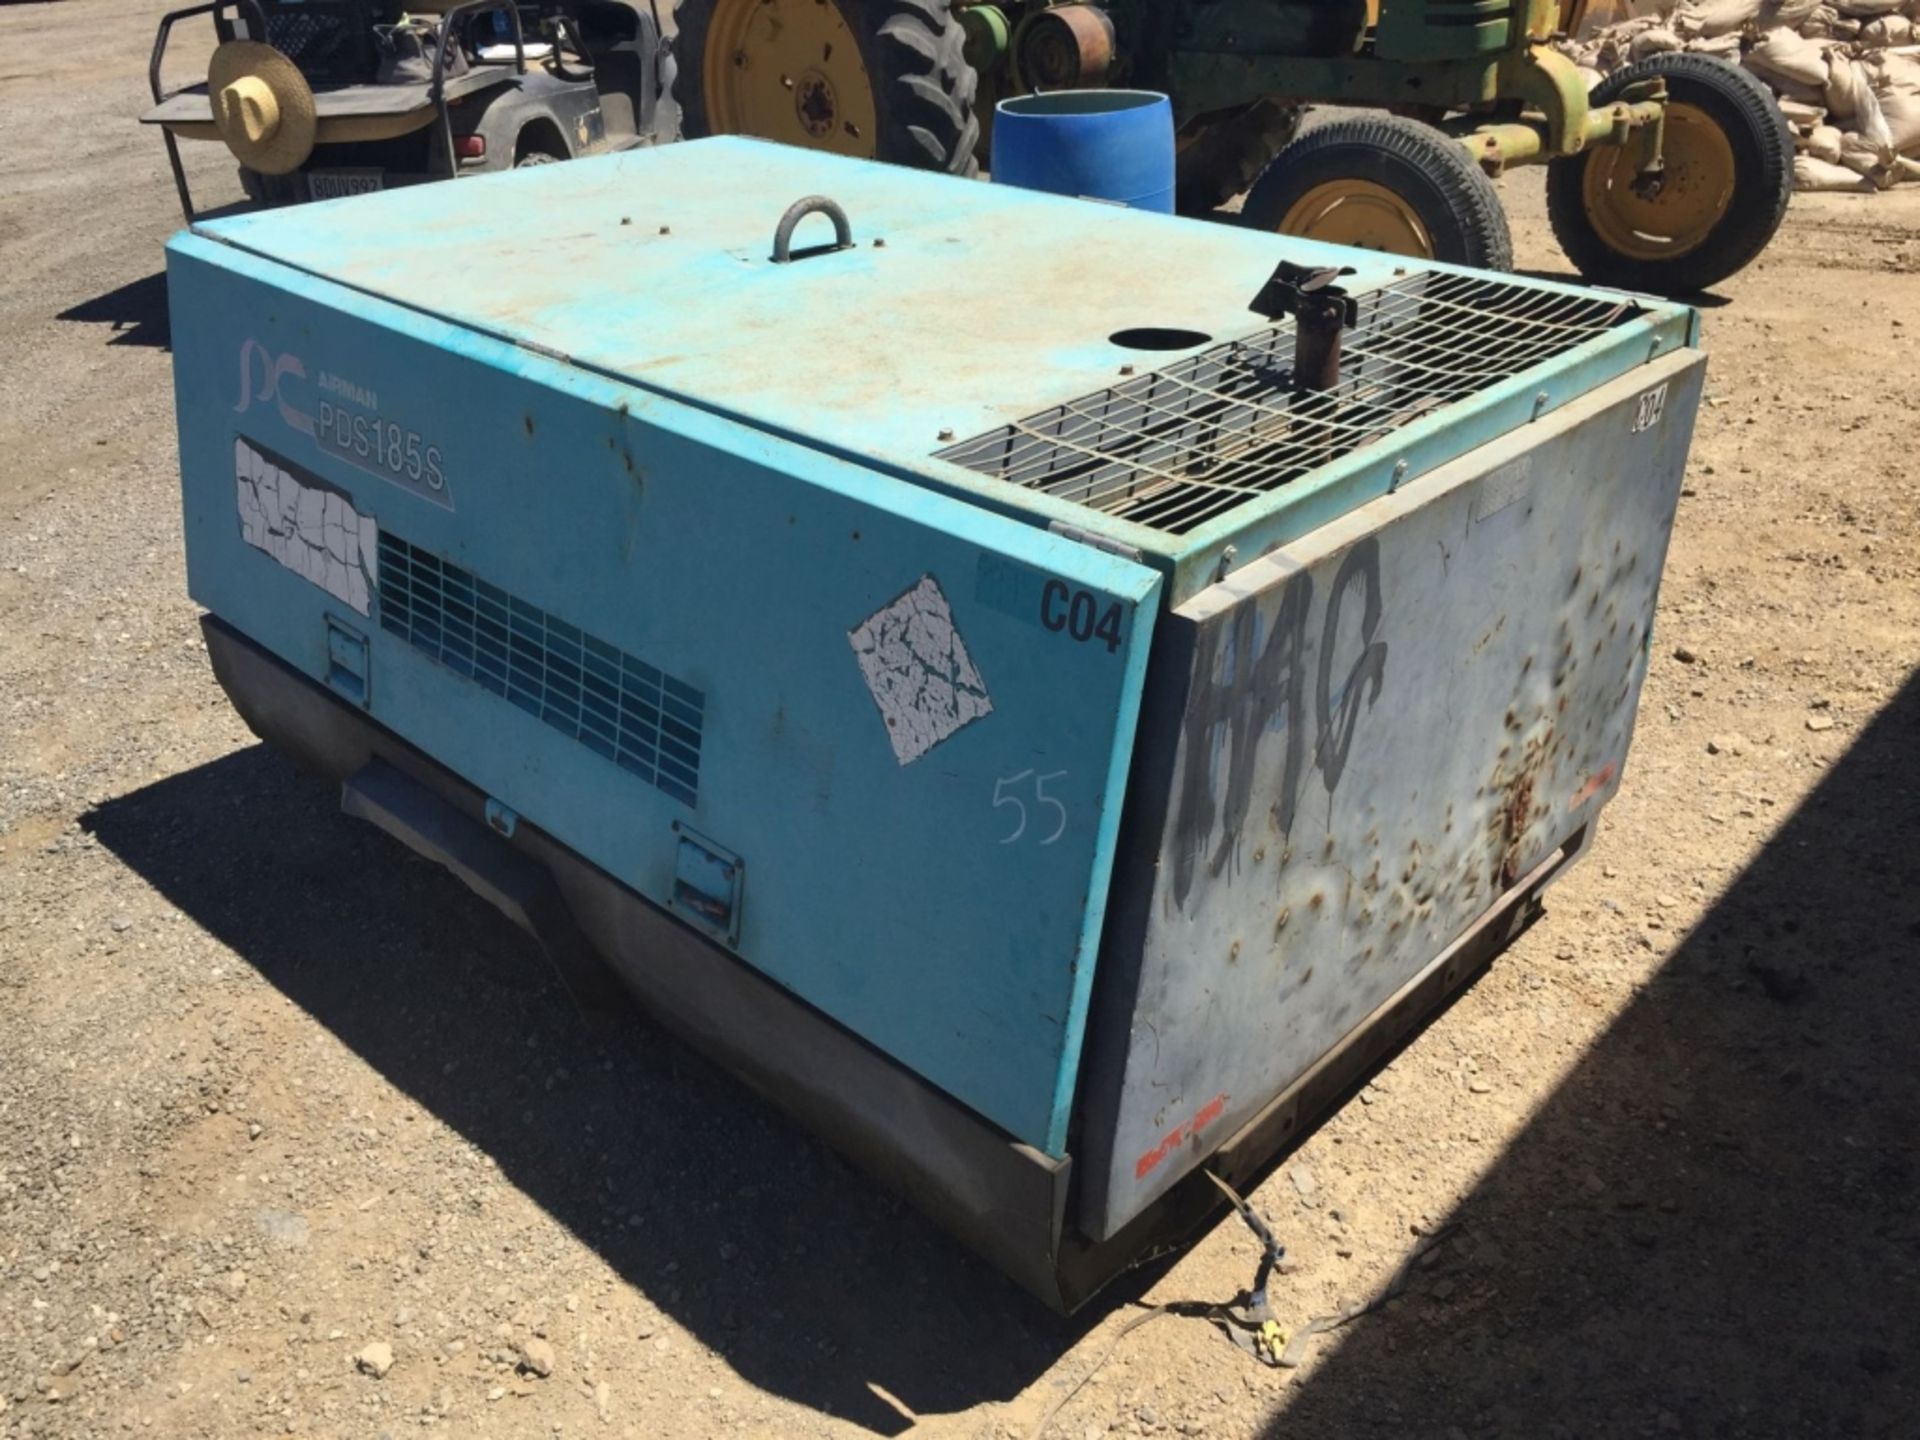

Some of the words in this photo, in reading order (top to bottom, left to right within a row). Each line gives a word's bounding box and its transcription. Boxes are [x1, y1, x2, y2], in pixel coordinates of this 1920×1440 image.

[319, 401, 448, 491] PDS185S
[1040, 579, 1123, 655] C04
[992, 769, 1068, 845] 55
